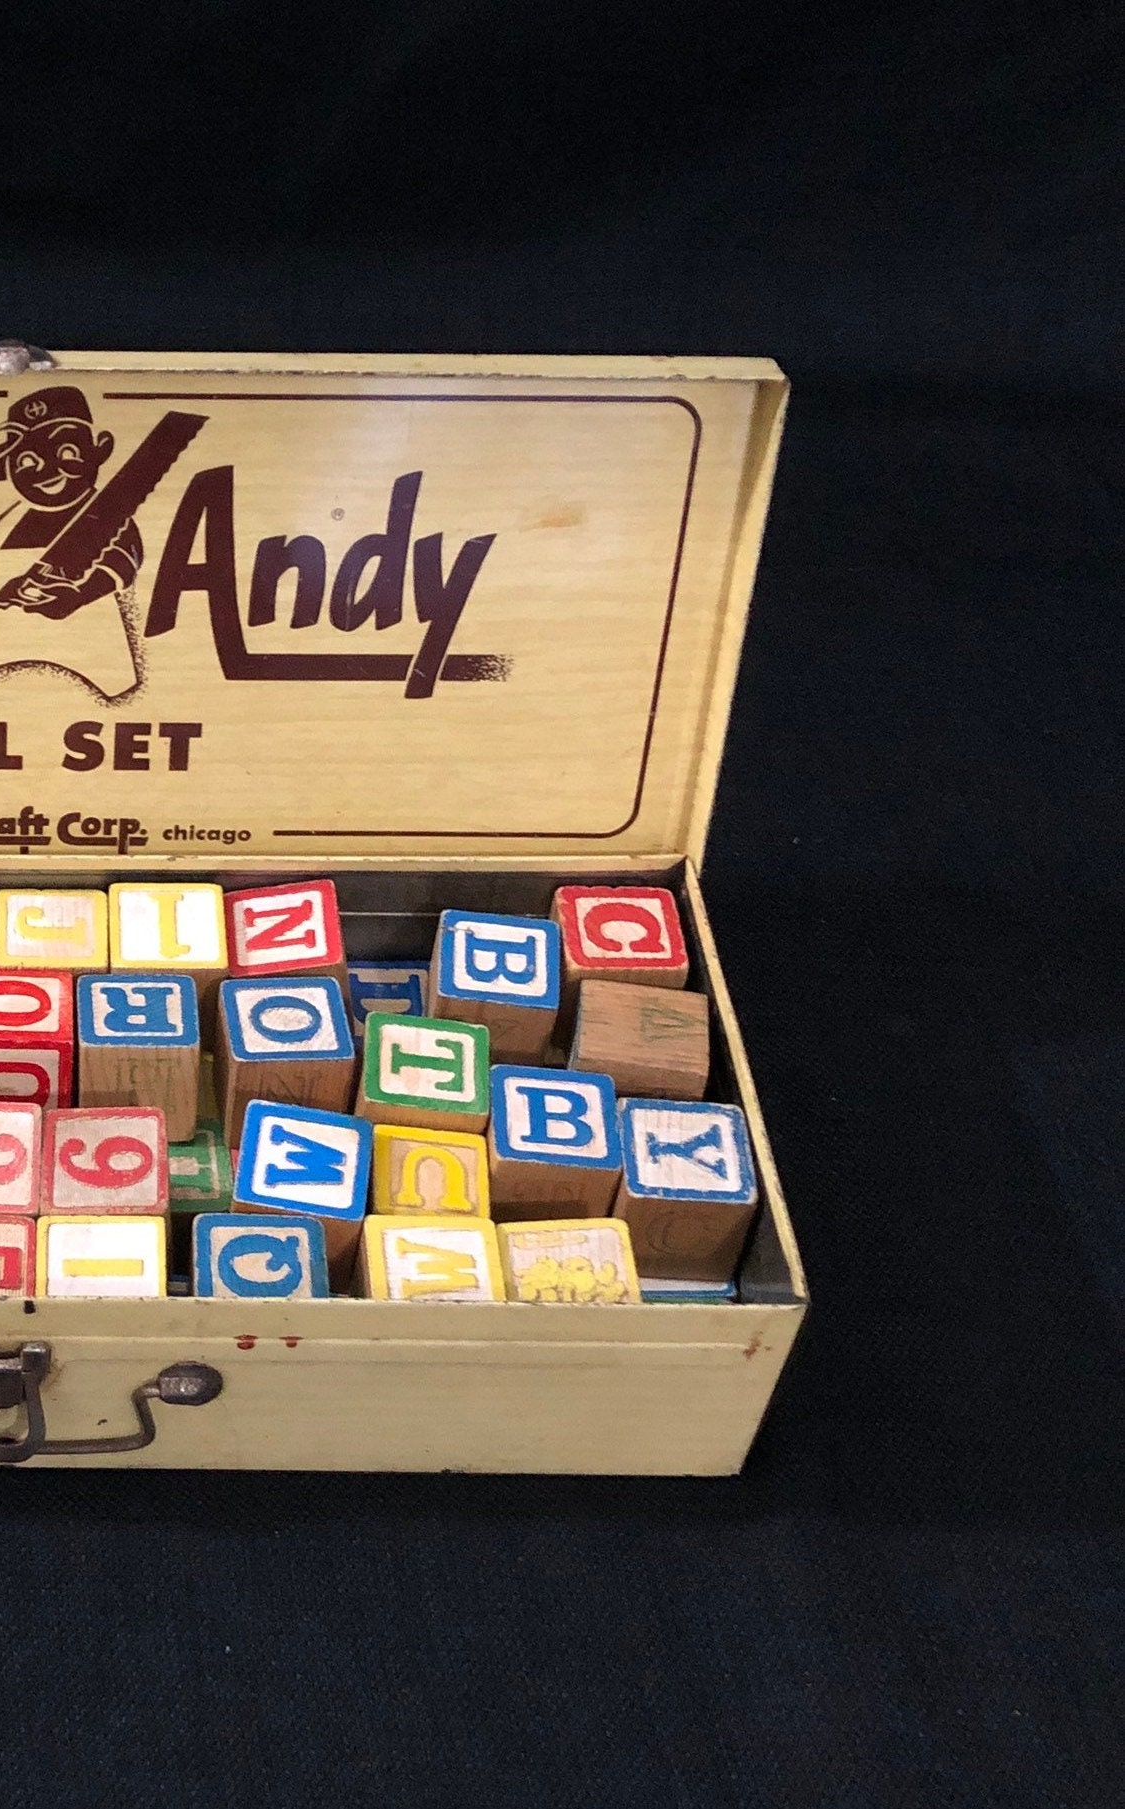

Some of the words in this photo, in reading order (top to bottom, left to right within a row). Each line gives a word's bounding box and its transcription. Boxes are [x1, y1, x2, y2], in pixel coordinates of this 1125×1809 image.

[144, 465, 511, 698] Andy
[62, 721, 203, 772] SET
[57, 811, 149, 855] Corp.
[162, 825, 252, 843] chicago
[464, 933, 537, 984] B
[100, 986, 177, 1033] R
[391, 1038, 465, 1092] T
[515, 1085, 594, 1148] B
[646, 1123, 728, 1181] Y
[218, 1233, 303, 1298] Q
